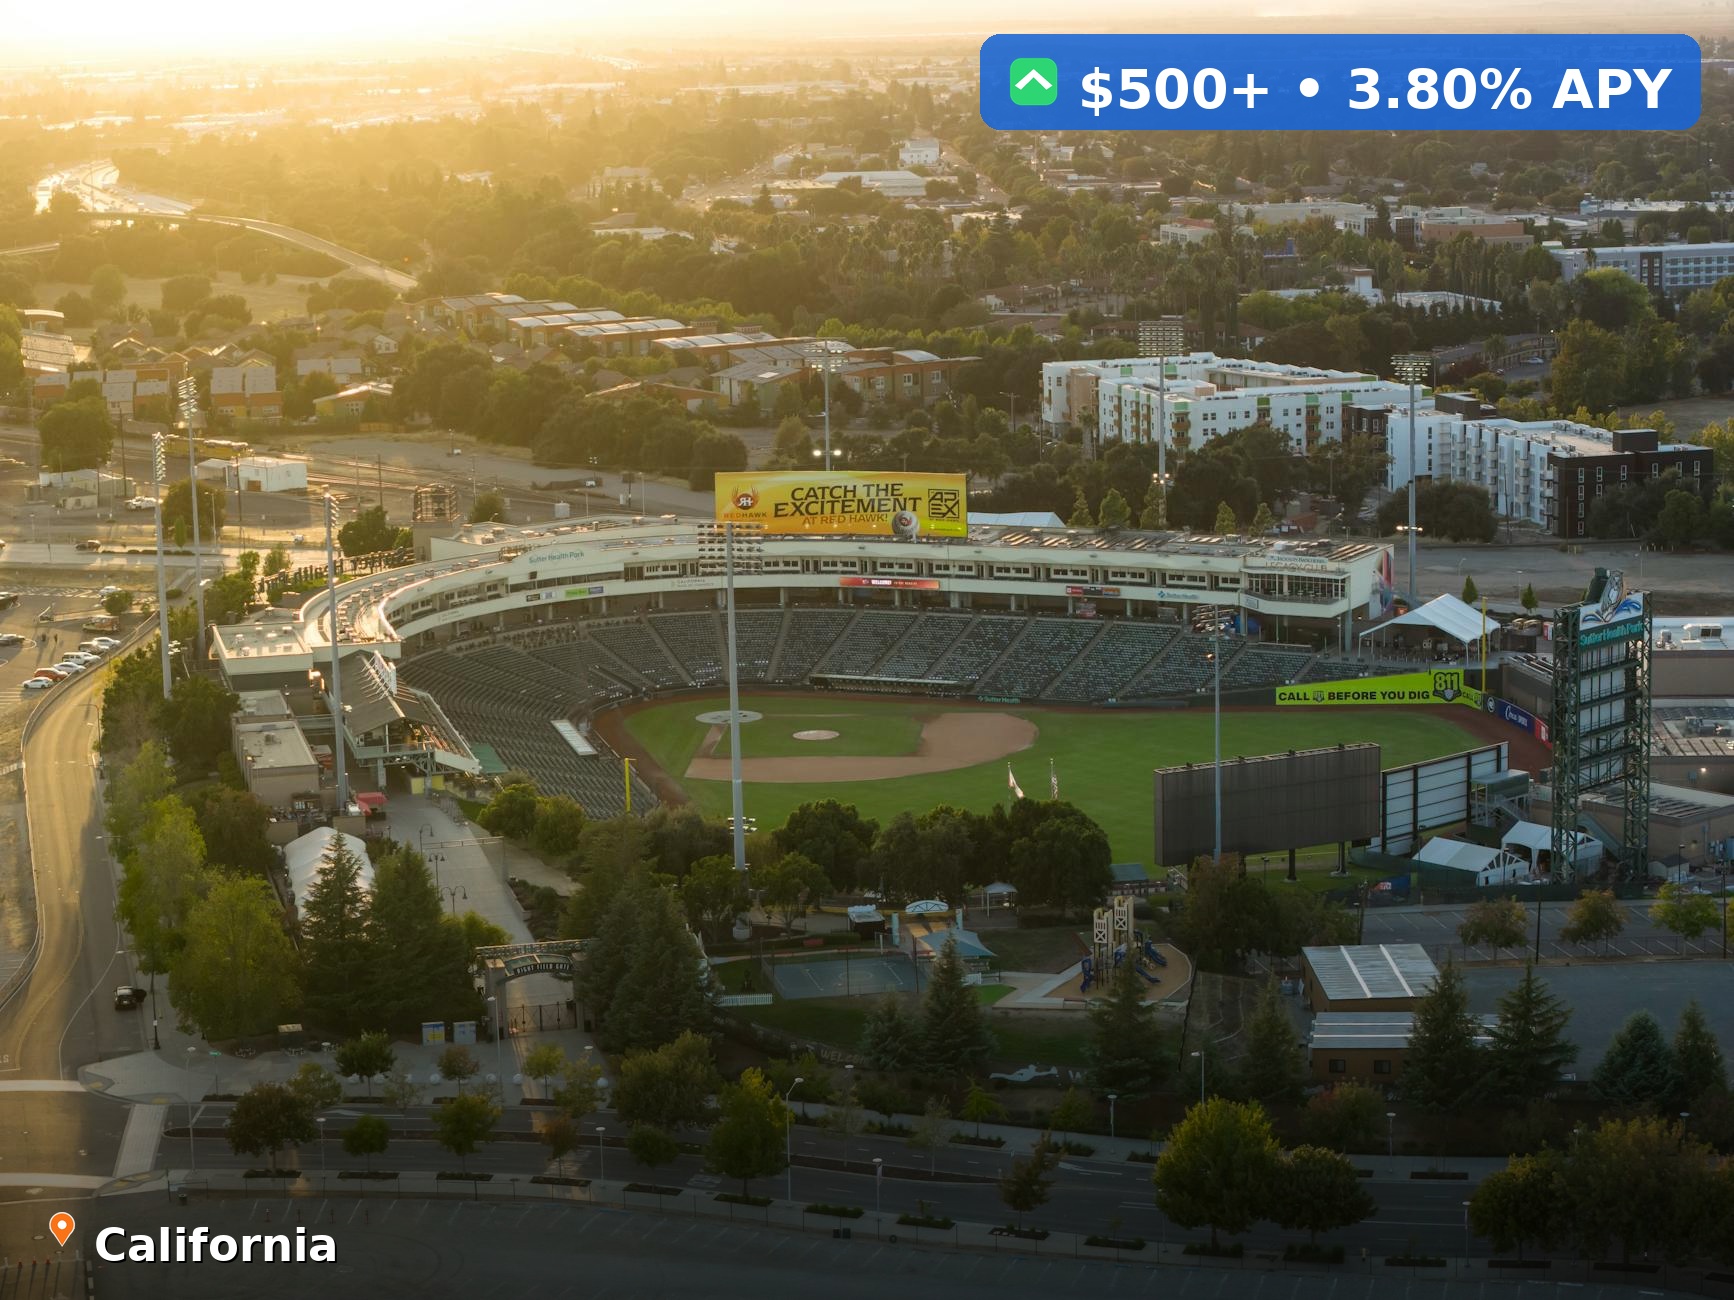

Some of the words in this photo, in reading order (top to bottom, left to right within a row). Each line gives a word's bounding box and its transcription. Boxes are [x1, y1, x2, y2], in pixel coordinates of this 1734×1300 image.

[790, 485, 857, 502] CATCH
[863, 483, 904, 498] THE
[773, 497, 922, 518] EXCITEMENT
[802, 515, 818, 526] AT
[820, 514, 846, 525] RED
[849, 513, 889, 523] HAWK!
[569, 550, 585, 559] Park
[1603, 624, 1627, 641] Health
[1627, 620, 1643, 635] Park
[1432, 671, 1460, 692] 811
[1278, 691, 1310, 701] CALL
[1327, 690, 1377, 701] BEFORE
[1380, 690, 1405, 700] YOU
[1408, 690, 1430, 700] DIG
